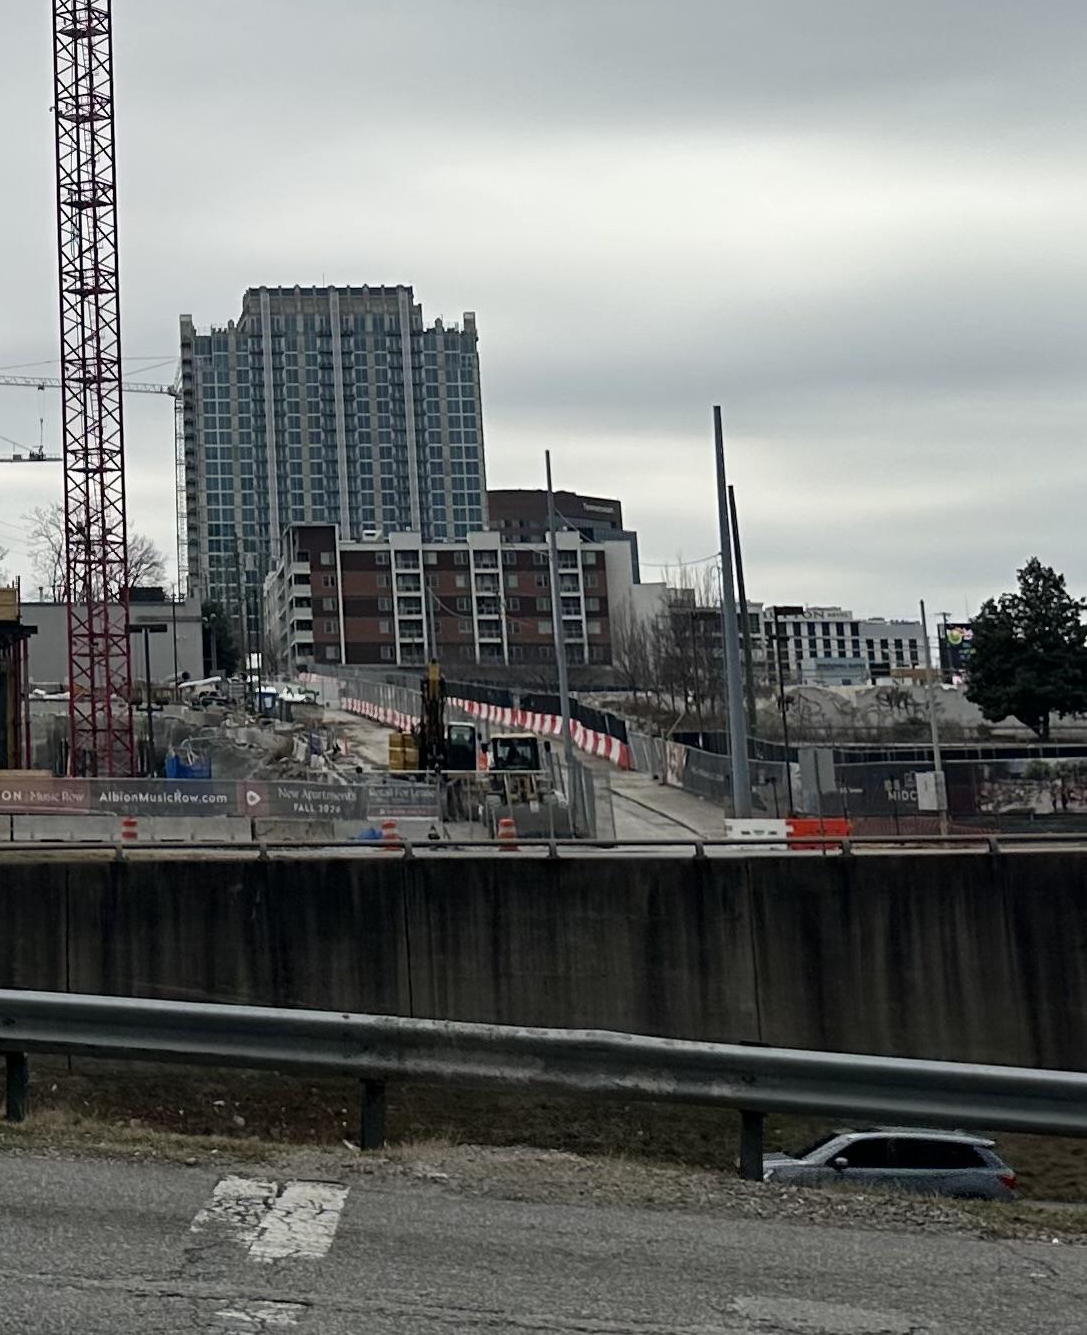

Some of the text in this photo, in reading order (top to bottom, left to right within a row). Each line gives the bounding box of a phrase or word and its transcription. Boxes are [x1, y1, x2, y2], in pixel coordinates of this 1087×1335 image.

[29, 790, 59, 803] Music
[61, 791, 85, 803] Row
[99, 790, 228, 804] AlbionMusicRow.com
[293, 803, 315, 813] FALL
